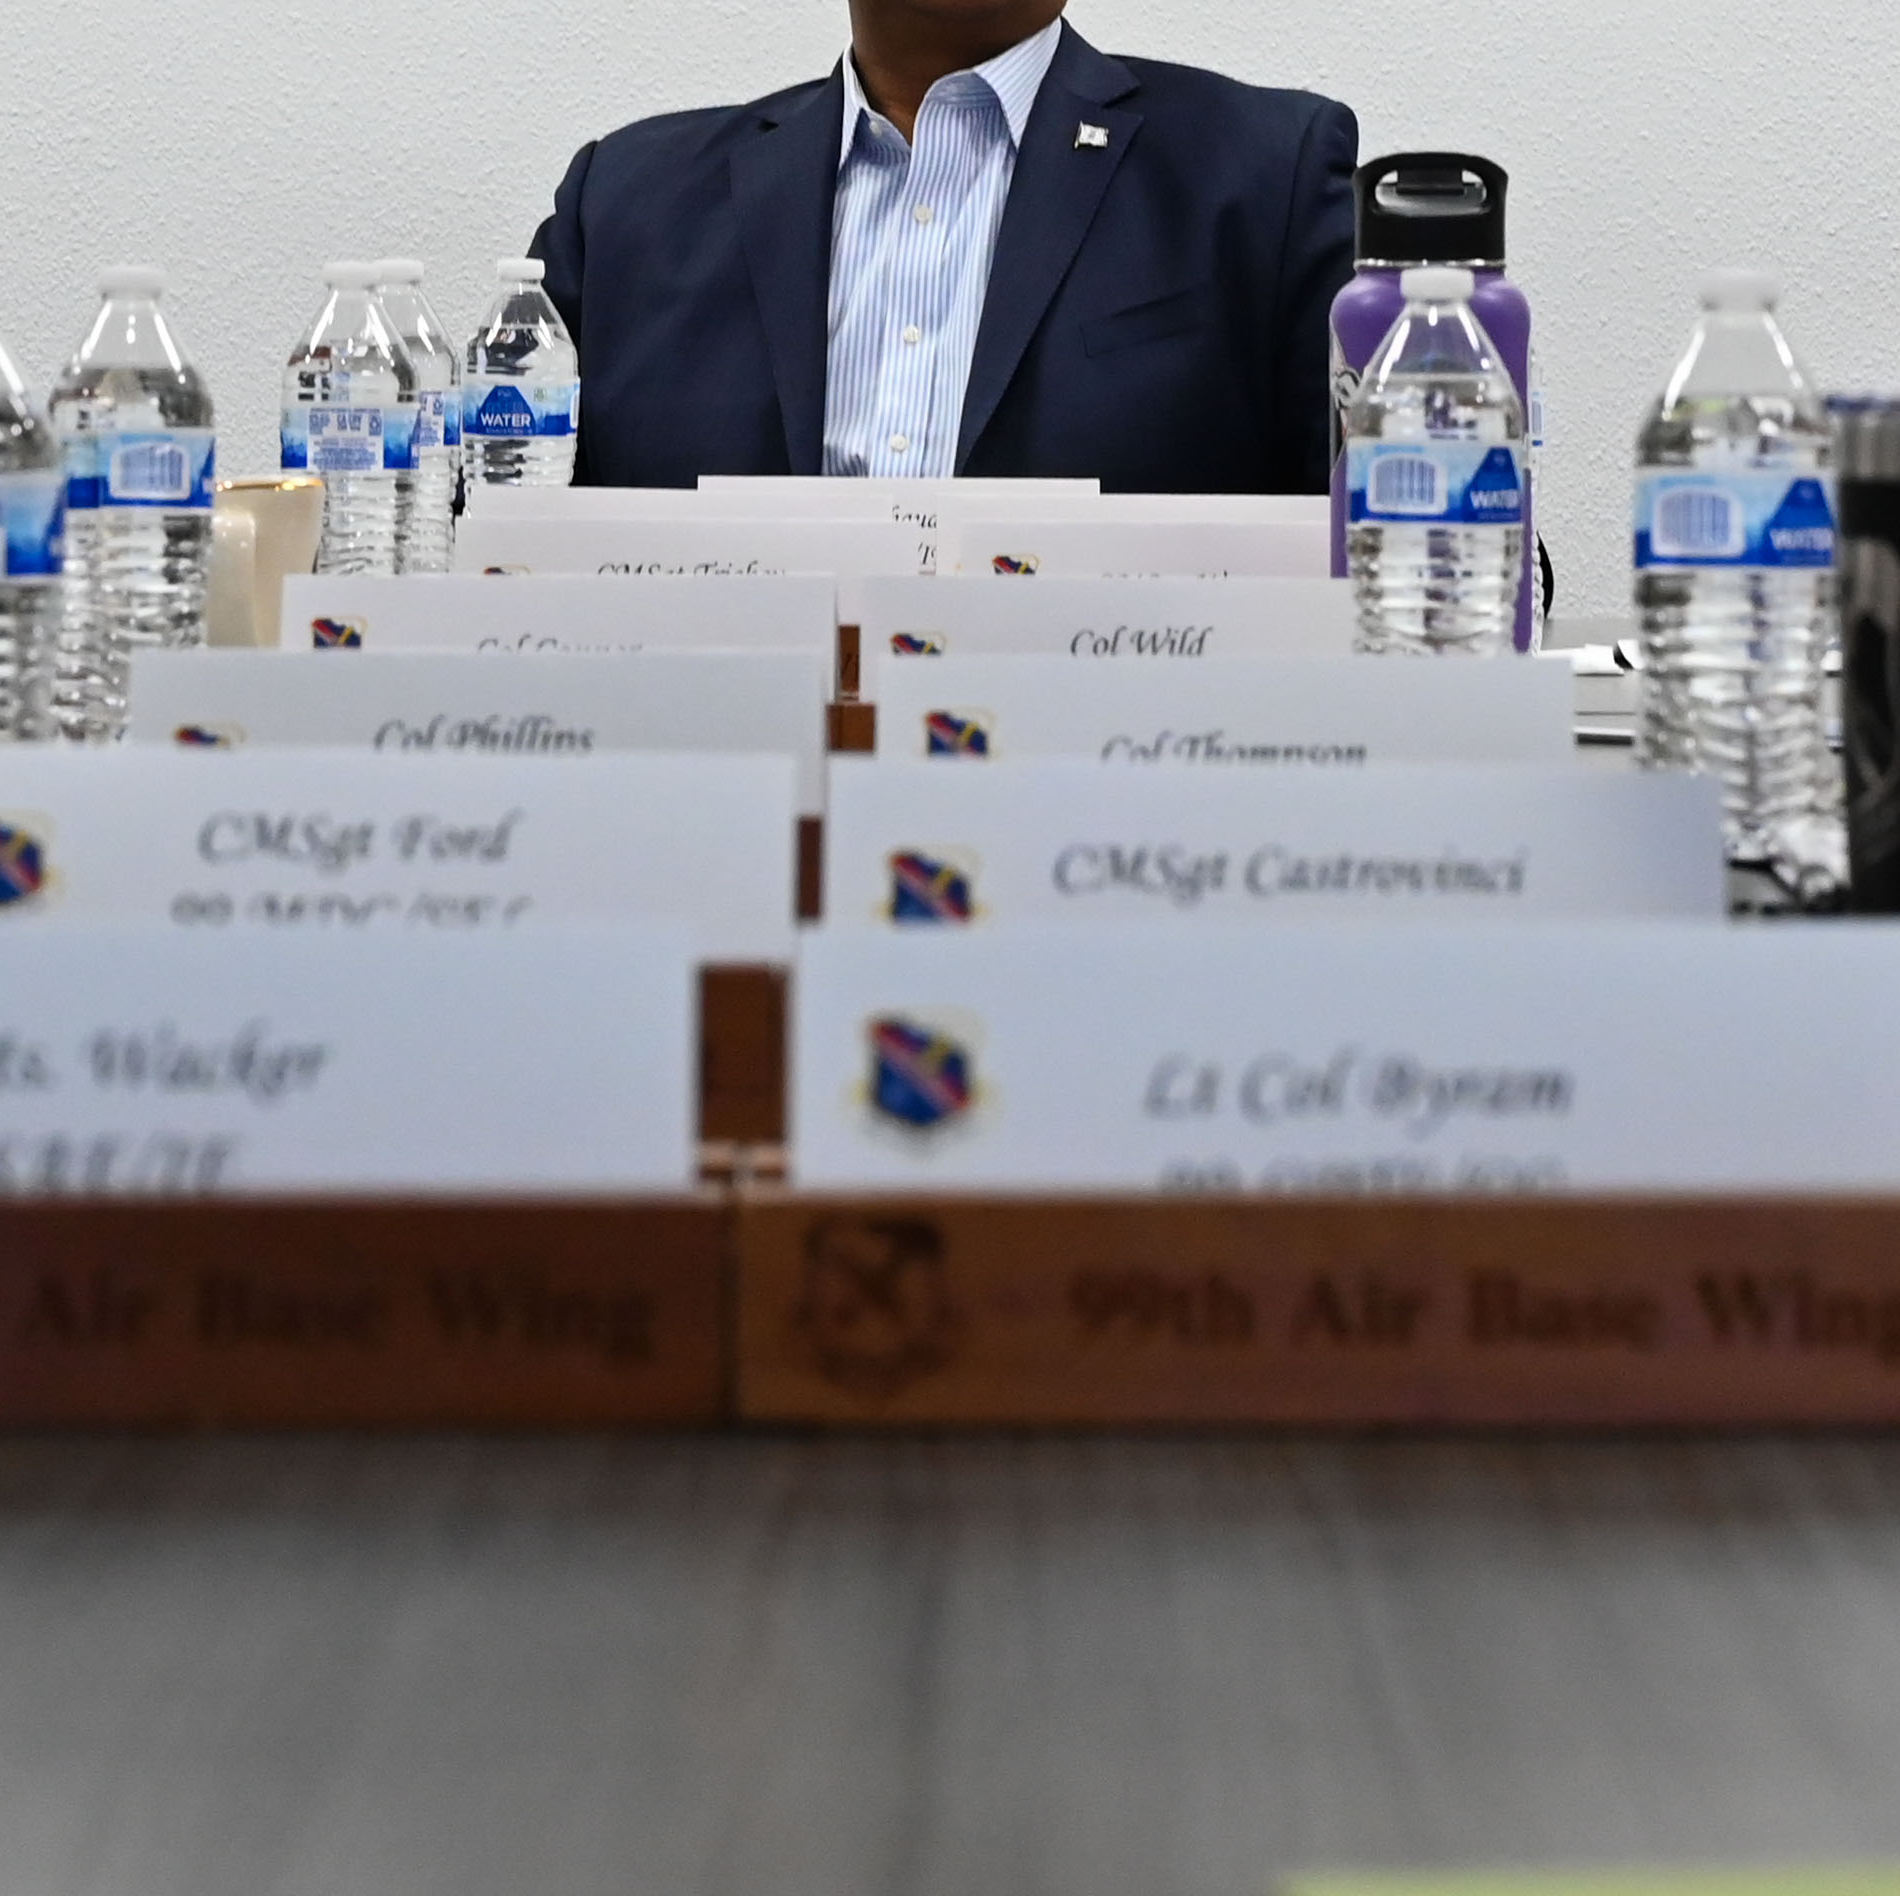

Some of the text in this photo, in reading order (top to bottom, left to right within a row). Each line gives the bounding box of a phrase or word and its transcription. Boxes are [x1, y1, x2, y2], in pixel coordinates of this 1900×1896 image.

[480, 412, 532, 428] WATER
[1069, 625, 1215, 656] Col Wild
[1234, 1044, 1360, 1127] Col
[22, 1267, 161, 1349] Air
[193, 1267, 389, 1350] Base
[423, 1264, 658, 1372] Wing
[1289, 1269, 1426, 1350] Air
[1465, 1269, 1663, 1352] Base
